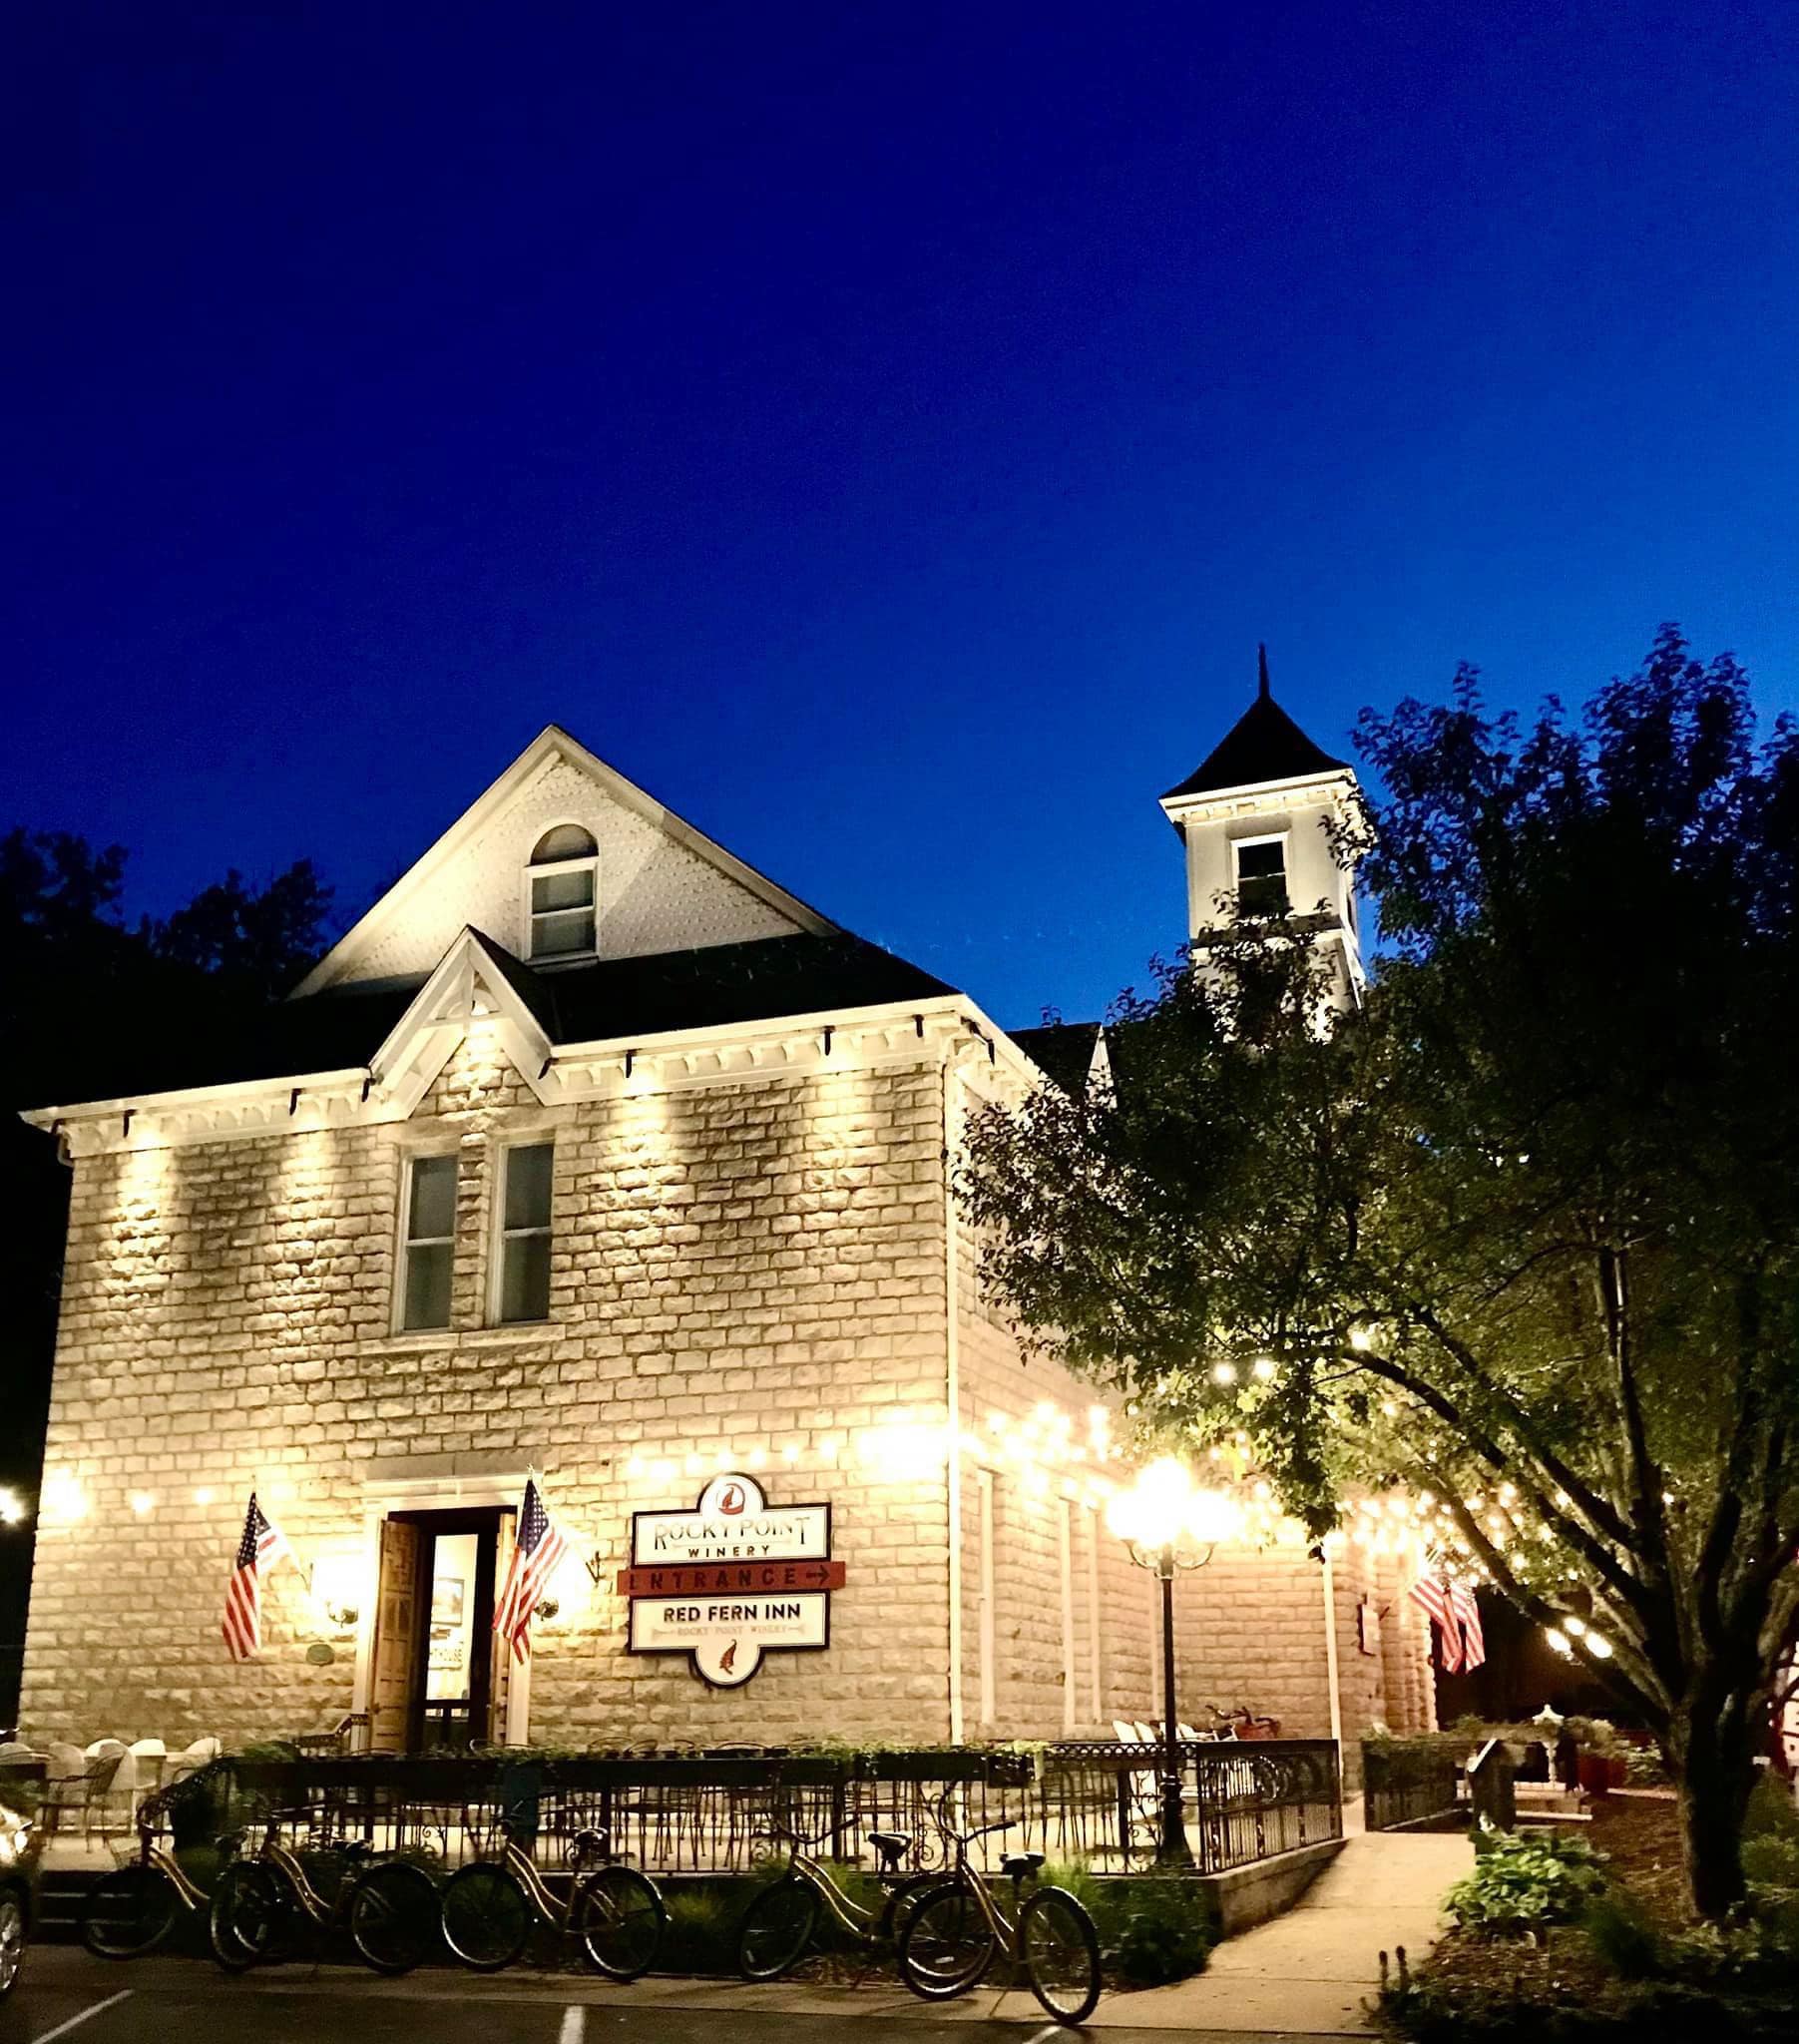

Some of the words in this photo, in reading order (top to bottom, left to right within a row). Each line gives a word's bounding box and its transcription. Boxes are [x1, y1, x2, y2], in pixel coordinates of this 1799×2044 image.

[654, 1523, 729, 1550] ROCKY
[738, 1516, 810, 1545] POINT
[688, 1545, 770, 1558] WINERY
[629, 1568, 796, 1590] ENTRANCE
[664, 1607, 700, 1623] RED
[707, 1604, 757, 1621] FERN
[765, 1603, 801, 1620] INN
